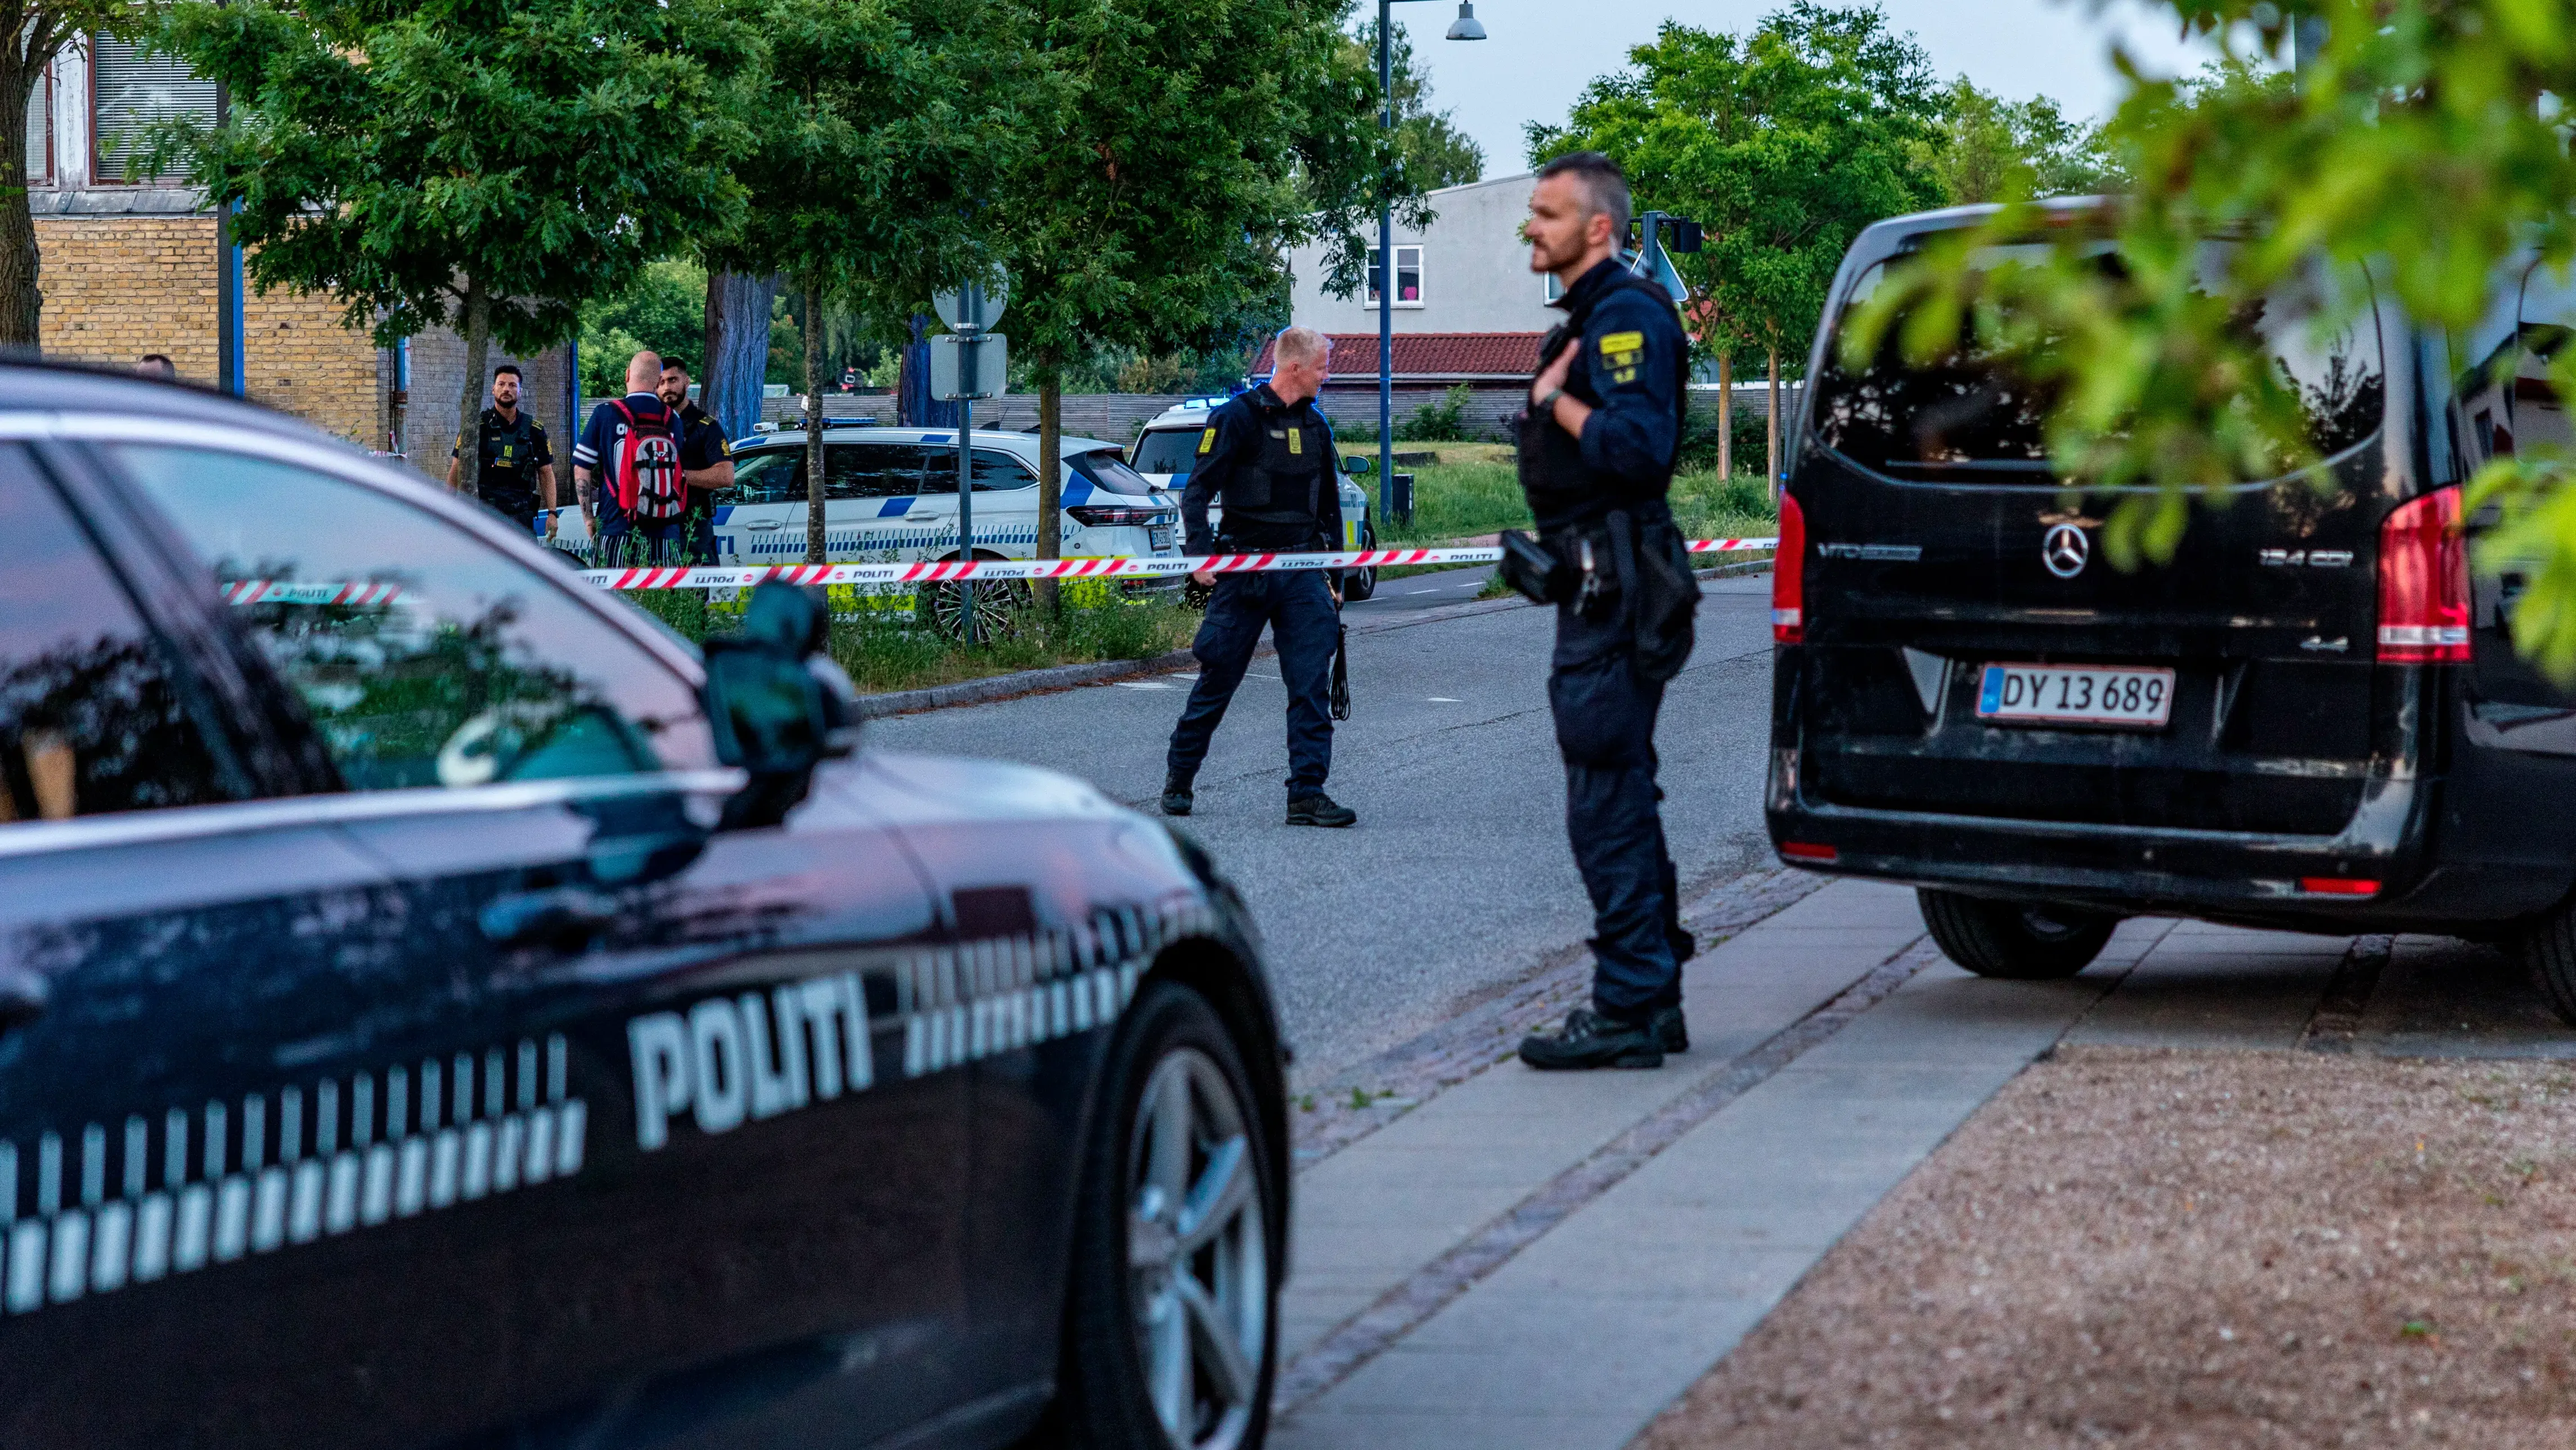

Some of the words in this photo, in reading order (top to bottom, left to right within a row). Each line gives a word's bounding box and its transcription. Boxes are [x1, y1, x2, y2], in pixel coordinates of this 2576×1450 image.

[853, 570, 894, 578] POLITI
[2003, 675, 2048, 708] DY
[2057, 676, 2094, 710] 13
[2103, 676, 2164, 713] 689
[626, 968, 874, 1152] POLITI
